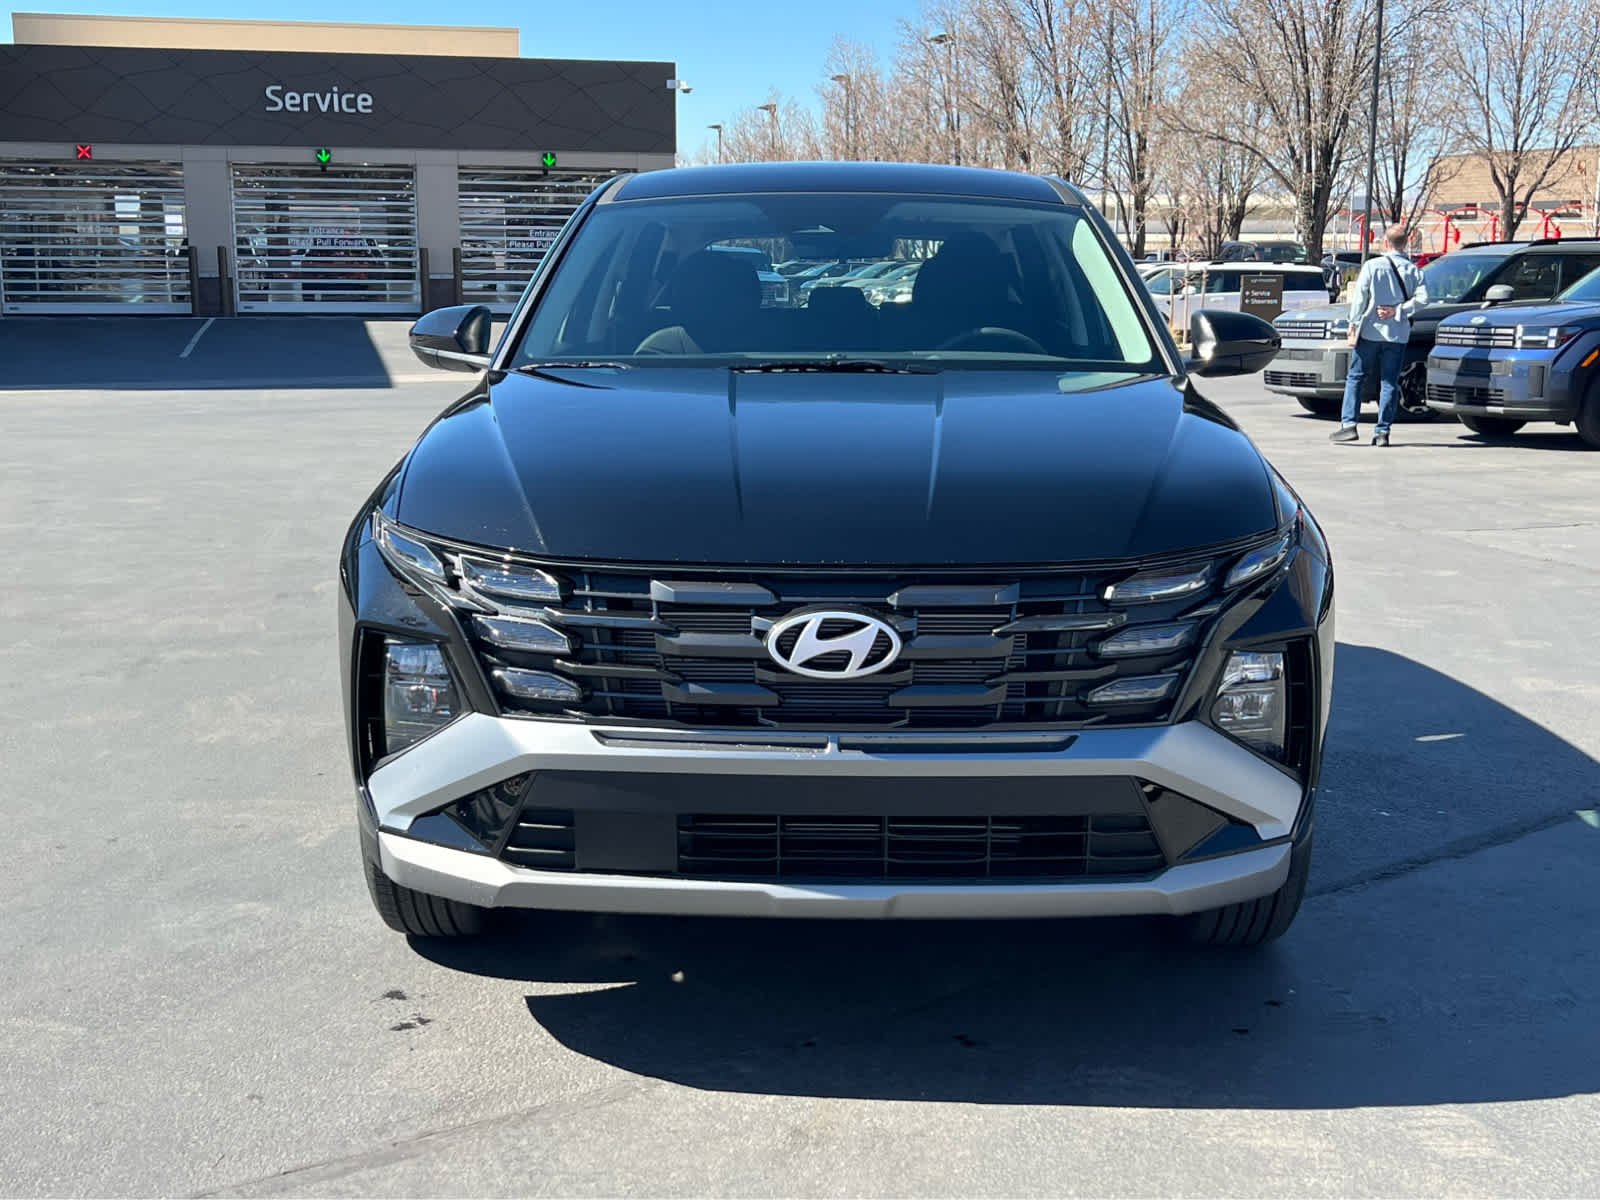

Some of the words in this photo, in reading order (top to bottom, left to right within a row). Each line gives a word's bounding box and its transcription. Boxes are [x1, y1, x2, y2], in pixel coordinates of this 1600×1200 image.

[265, 85, 373, 113] Service
[529, 229, 561, 238] Entranc
[317, 238, 332, 248] Pull
[334, 239, 368, 249] Forward
[509, 240, 535, 248] Please
[536, 240, 552, 249] Pull
